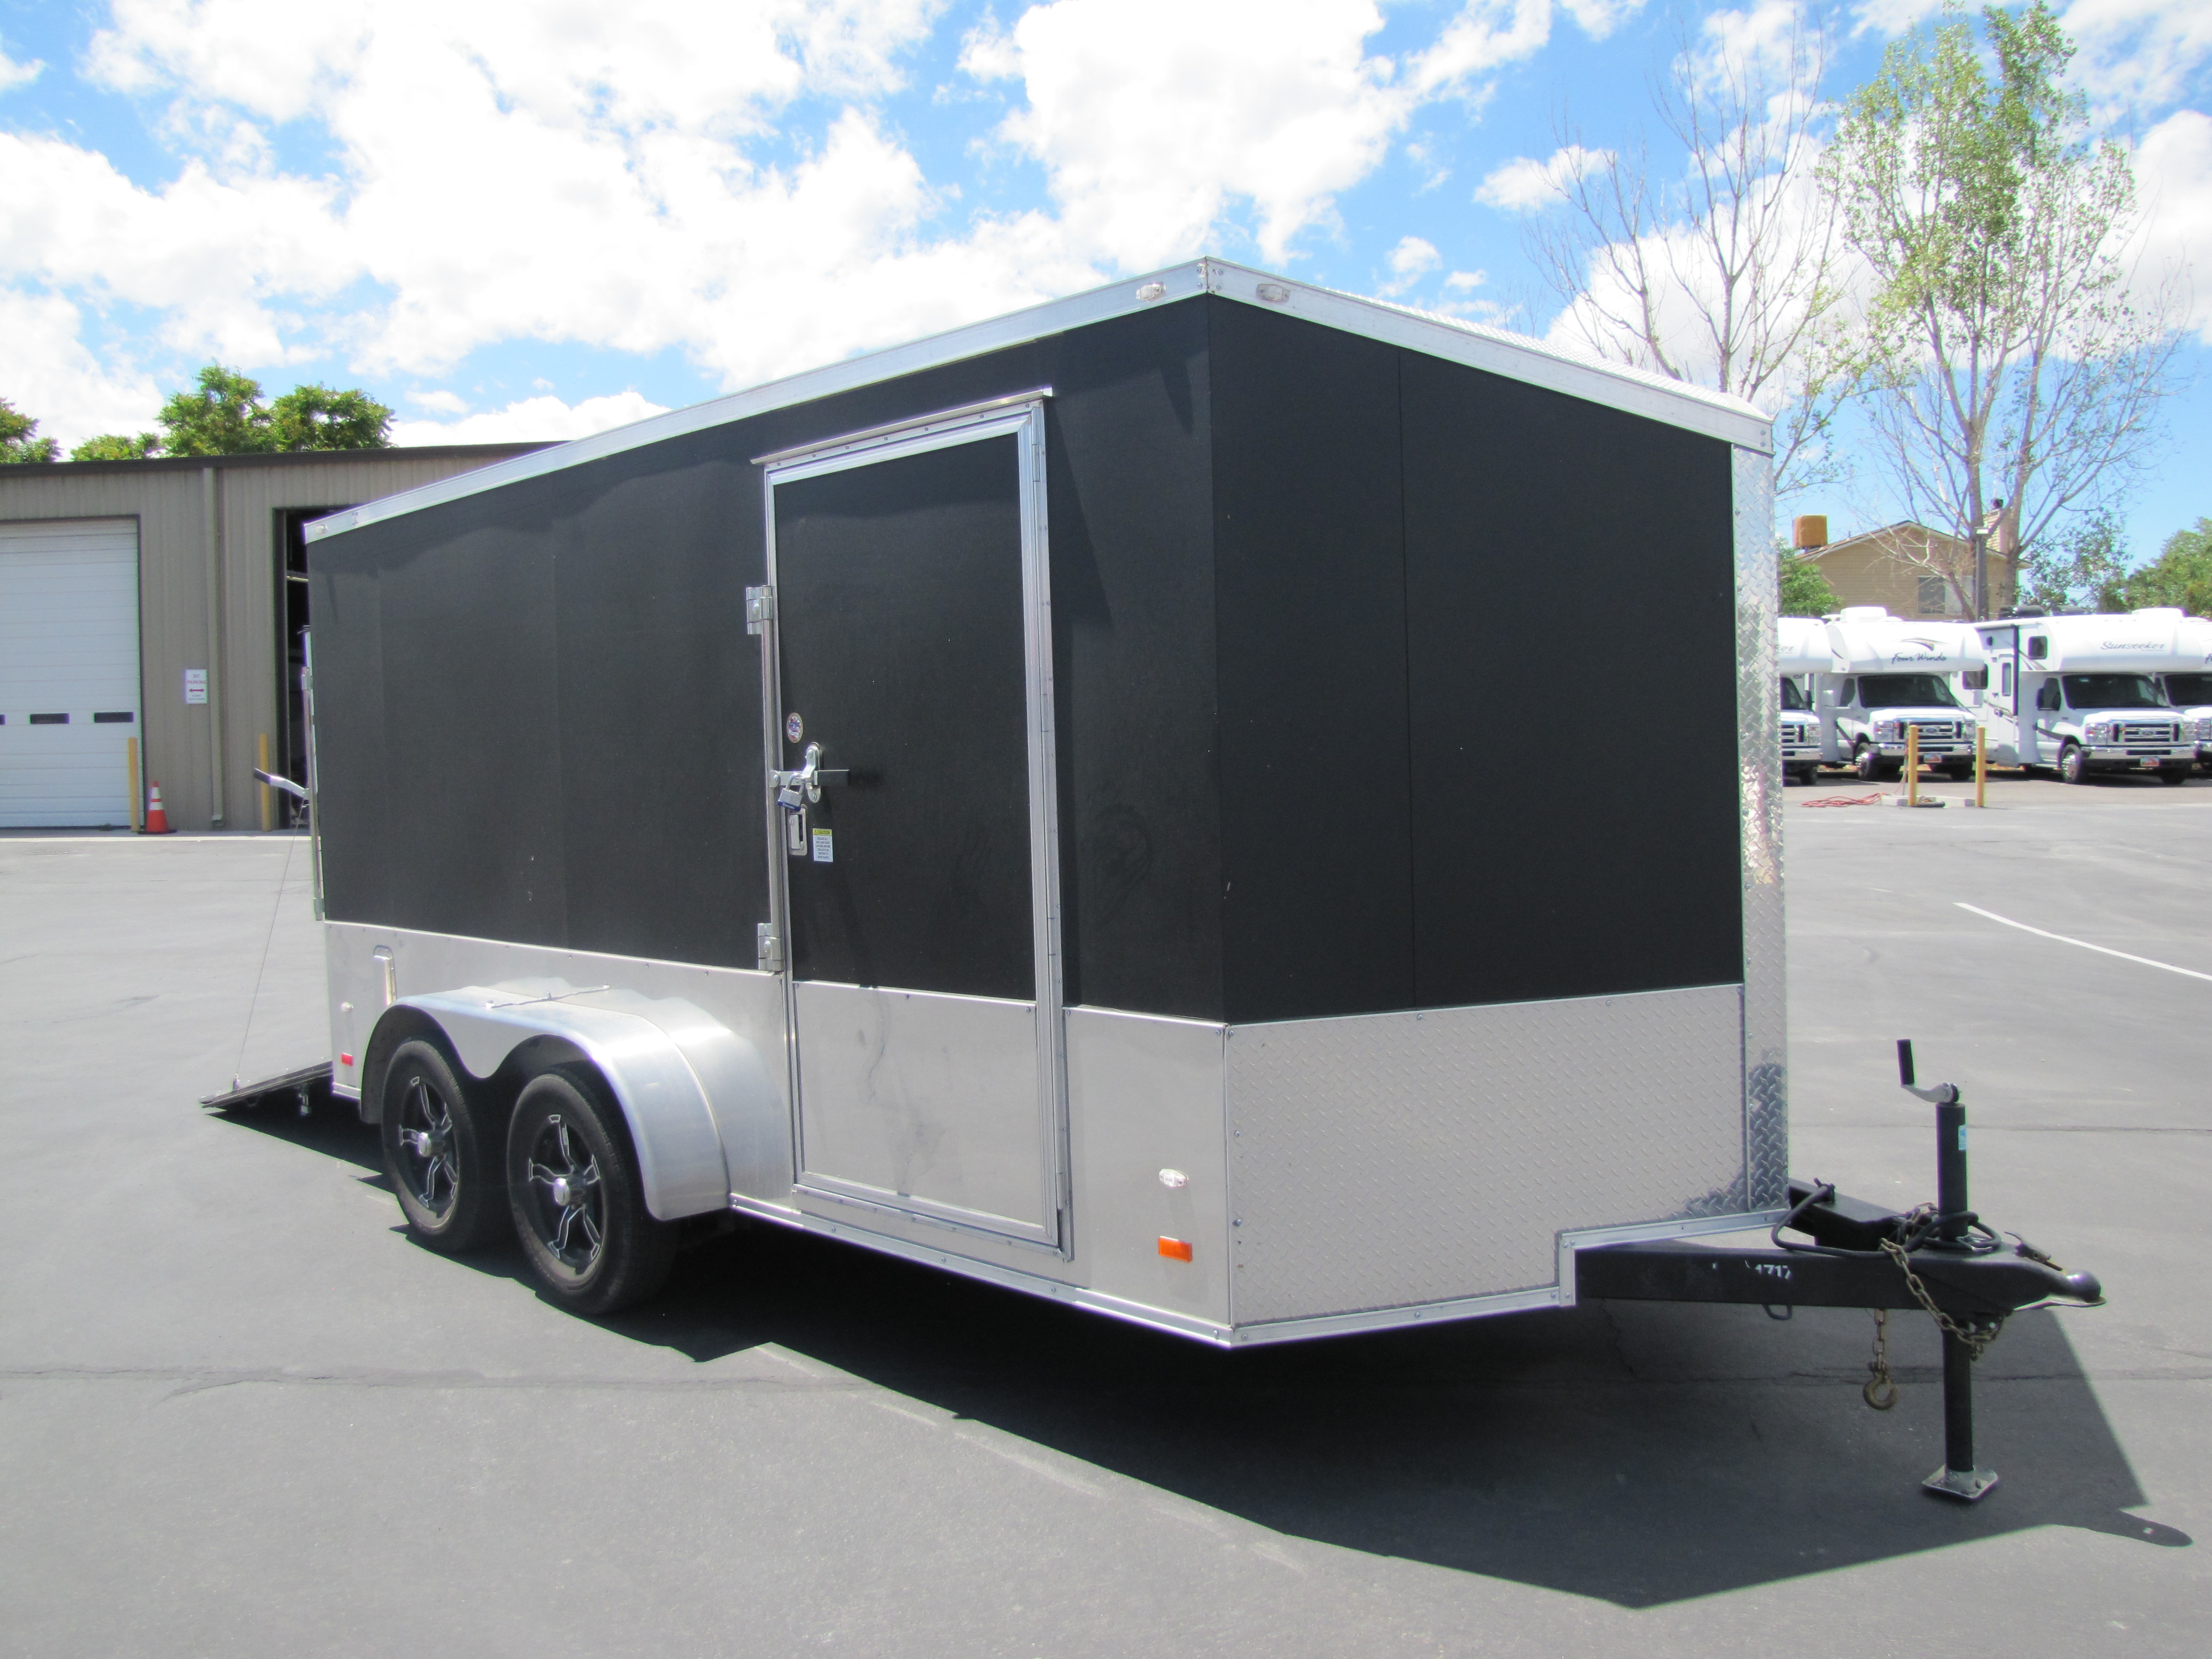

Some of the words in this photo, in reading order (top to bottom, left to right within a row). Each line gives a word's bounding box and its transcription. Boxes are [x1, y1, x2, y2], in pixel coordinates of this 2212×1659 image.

[2100, 641, 2164, 650] Sunseeker
[1891, 652, 1913, 664] Four
[1915, 651, 1947, 661] Winds
